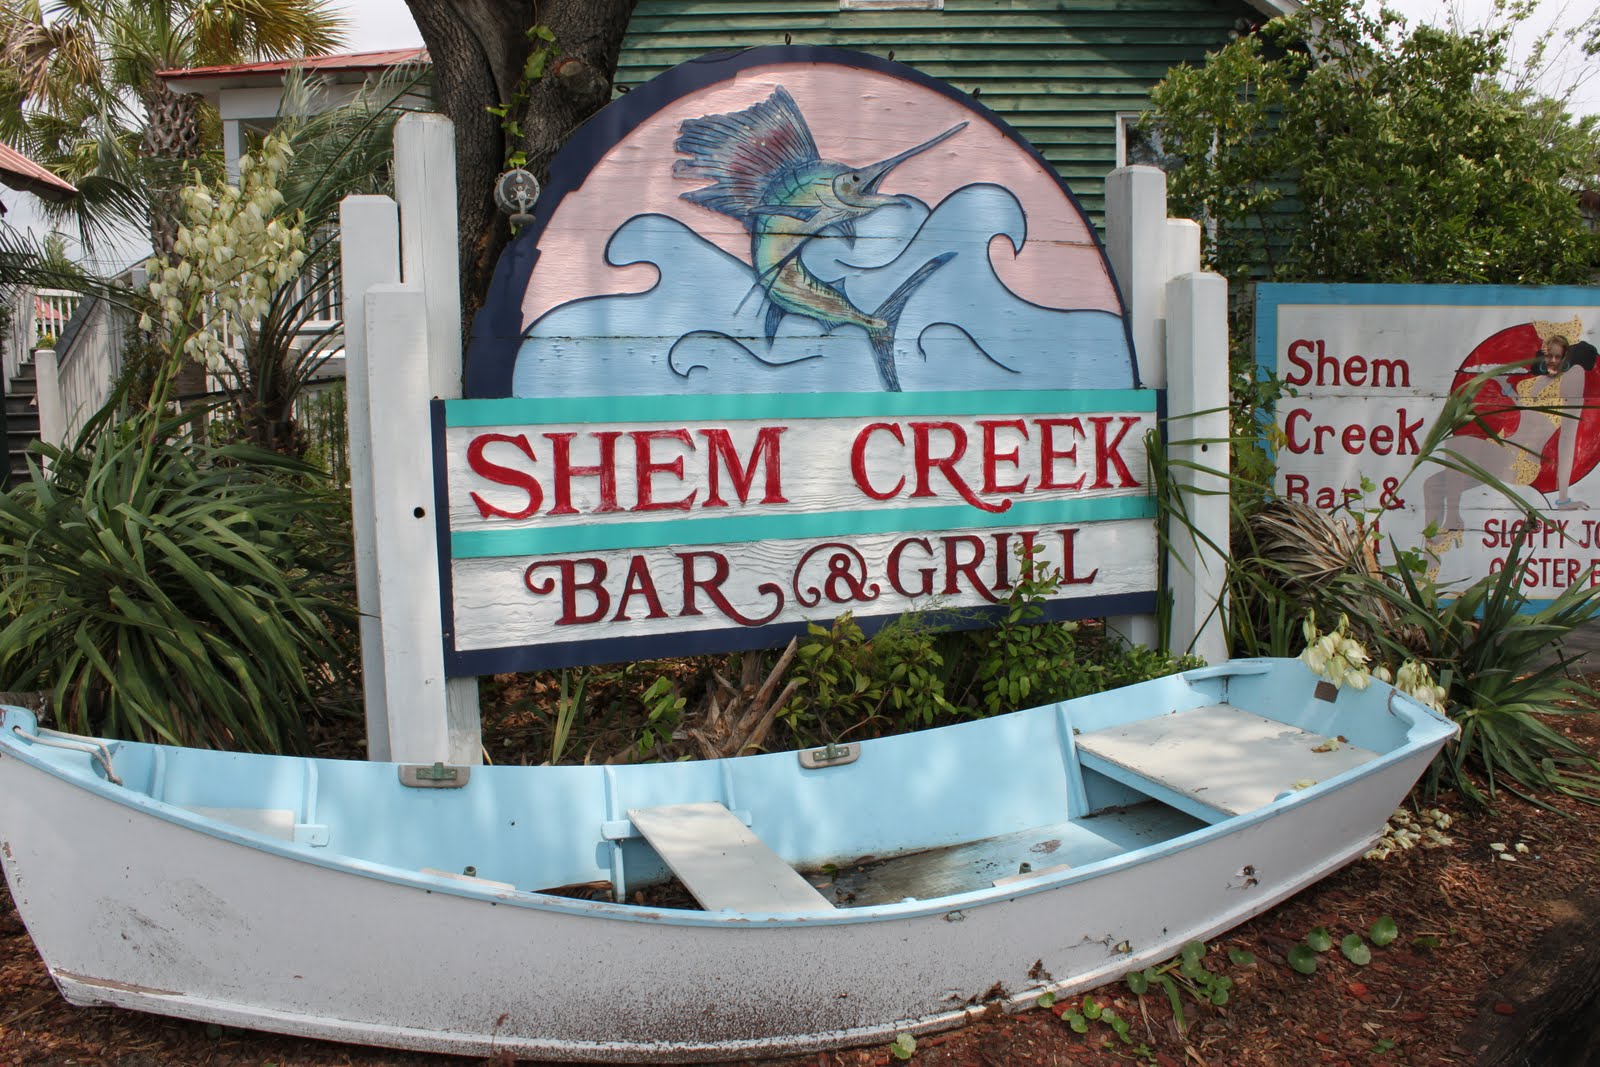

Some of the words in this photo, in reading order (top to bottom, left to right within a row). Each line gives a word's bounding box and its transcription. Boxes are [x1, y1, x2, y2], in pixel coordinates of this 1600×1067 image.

[1285, 339, 1411, 388] Shem
[1284, 408, 1425, 456] Creek
[466, 426, 790, 520] SHEM
[850, 416, 1142, 514] CREEK
[1284, 473, 1361, 510] Bar
[1379, 476, 1406, 511] &
[1481, 518, 1570, 549] SLOPPY
[524, 551, 785, 627] BAR
[792, 542, 881, 608] &
[886, 527, 1099, 605] GRILL
[1488, 556, 1582, 588] OSTER
